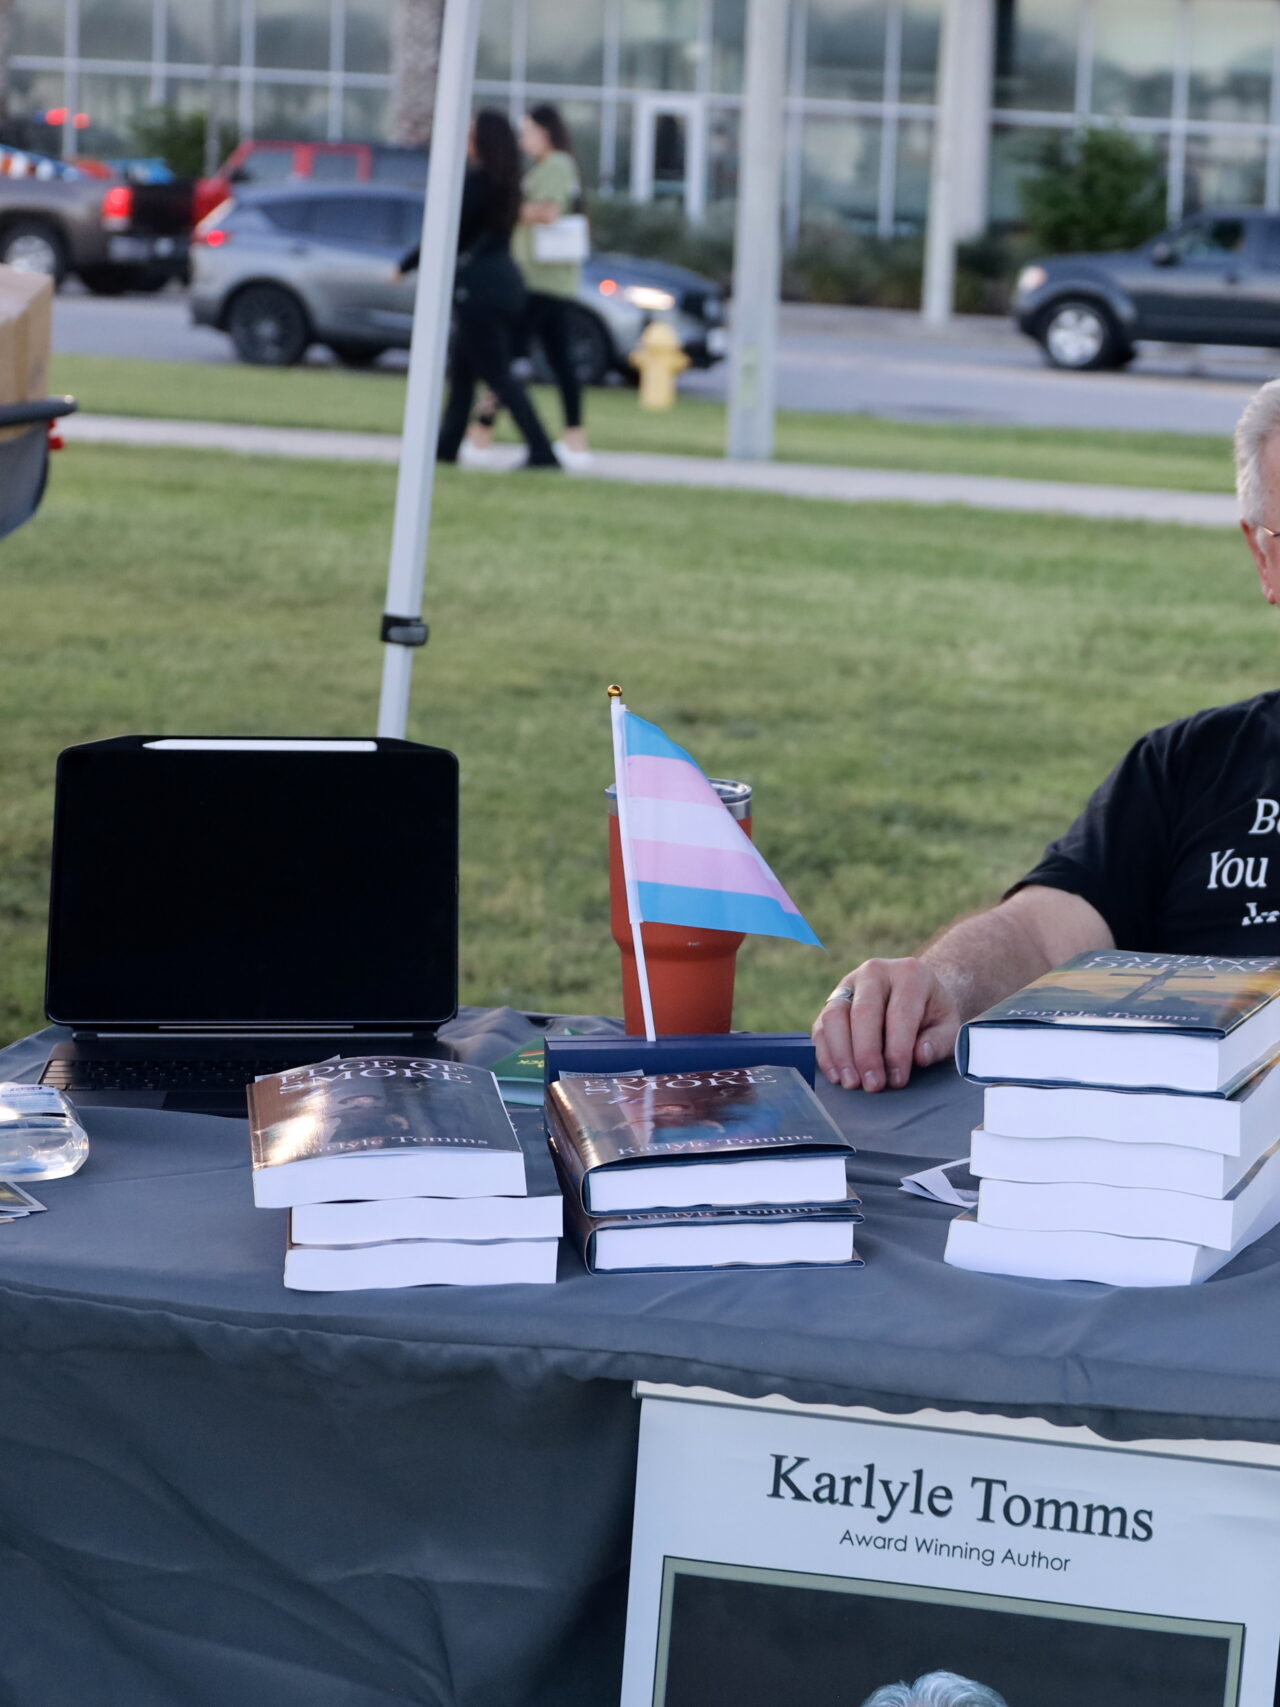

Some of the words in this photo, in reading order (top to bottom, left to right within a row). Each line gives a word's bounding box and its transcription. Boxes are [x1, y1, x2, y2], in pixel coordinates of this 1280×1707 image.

[1207, 849, 1269, 890] You
[1106, 1011, 1201, 1021] Tomms
[279, 1060, 397, 1084] EDGE
[409, 1061, 465, 1072] OF
[279, 1068, 472, 1095] SMOKE
[584, 1075, 777, 1096] SMOKE
[391, 1136, 488, 1145] Tomms
[618, 1140, 710, 1155] Karlyle
[717, 1135, 814, 1146] Tomms
[766, 1452, 954, 1524] Karlyle
[969, 1475, 1155, 1543] Tomms
[839, 1529, 908, 1553] Award
[914, 1536, 996, 1567] Winning
[1000, 1548, 1071, 1572] Author
